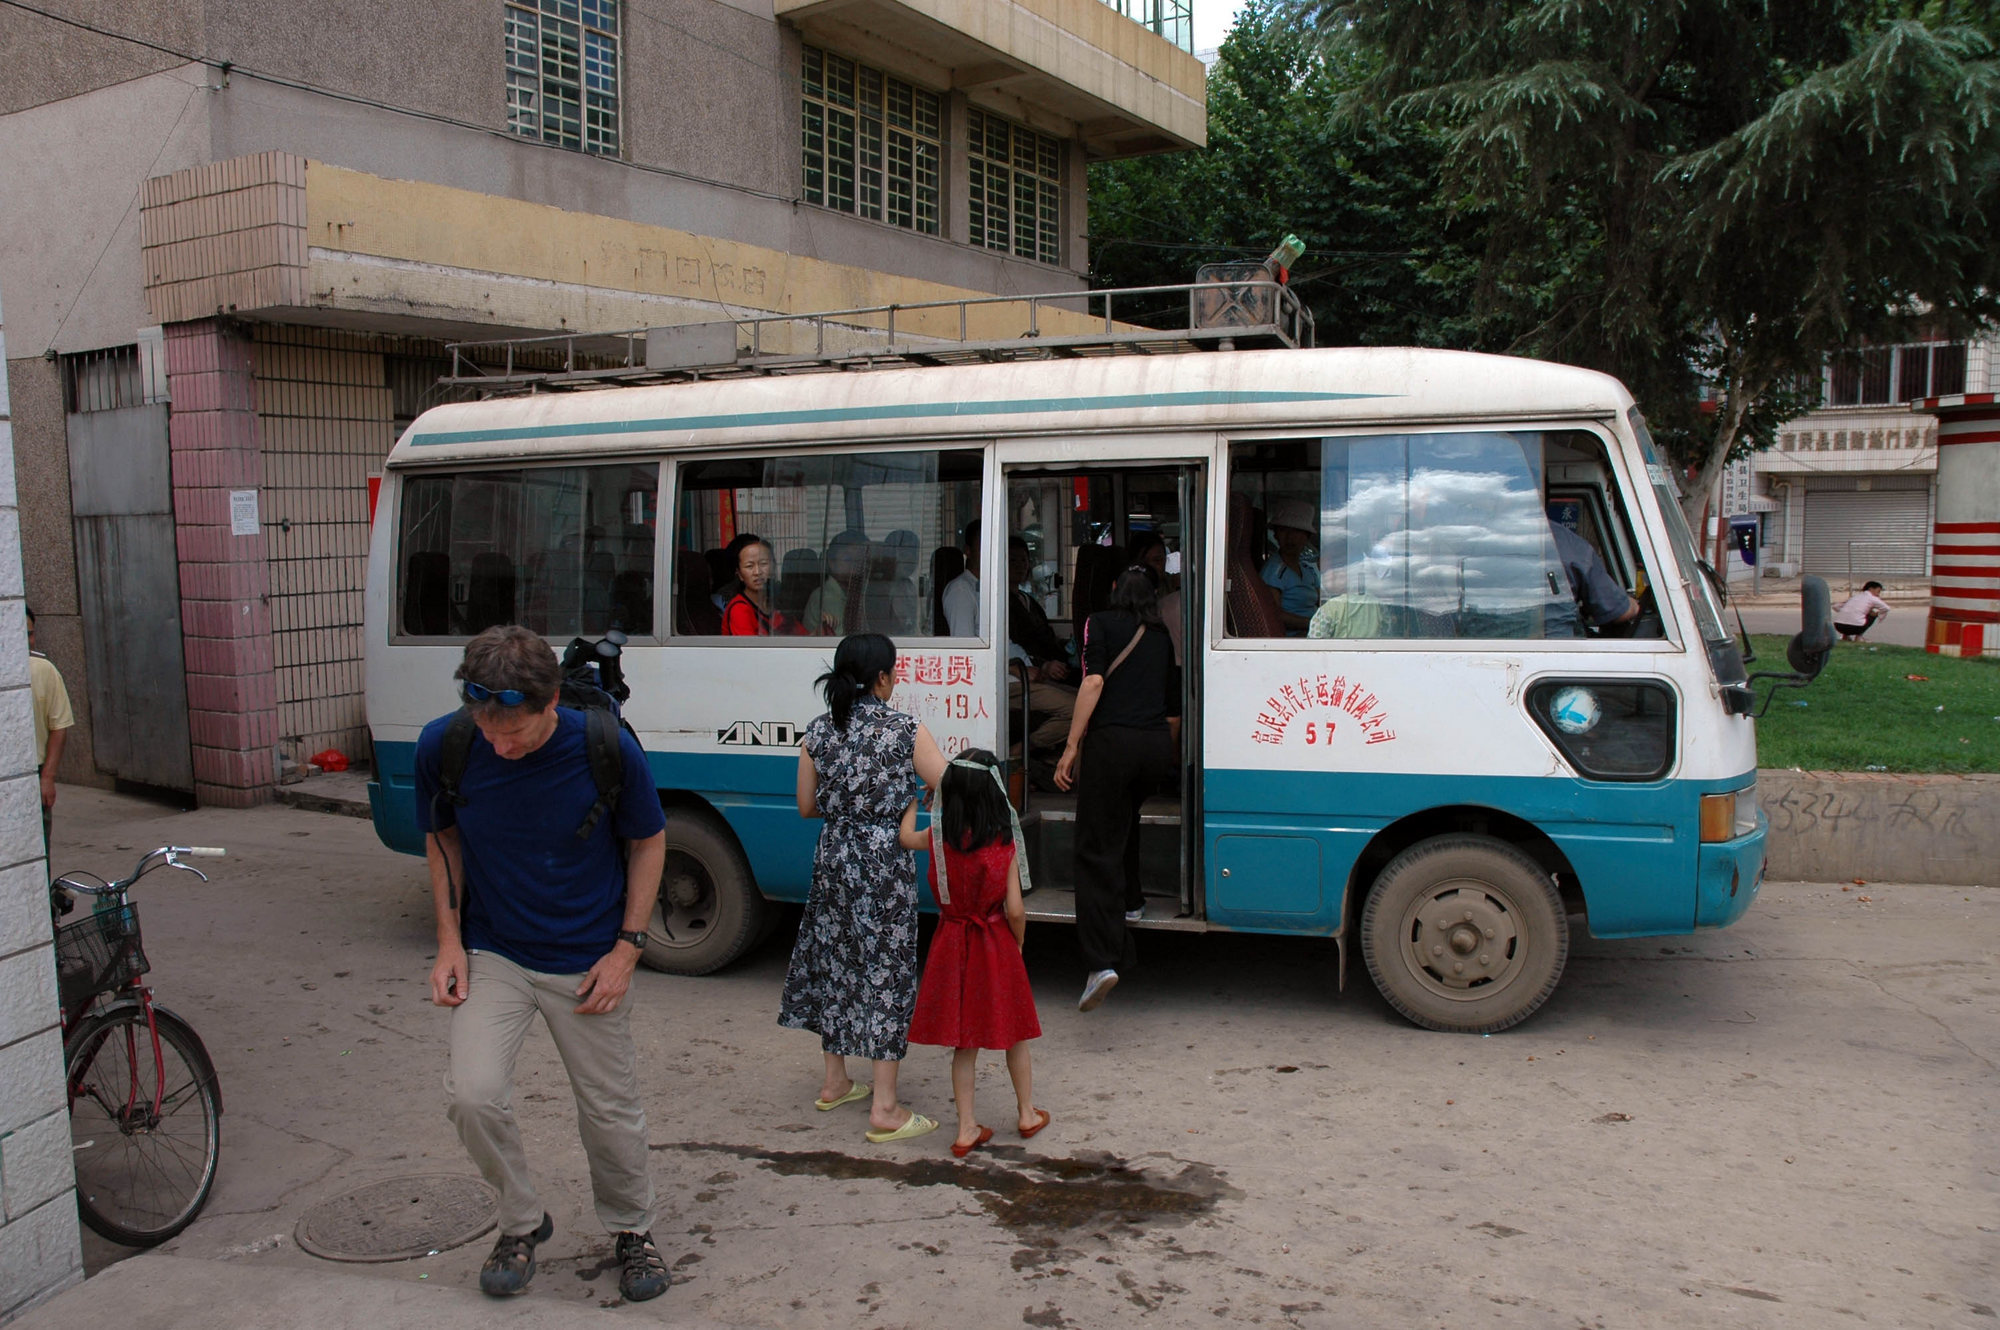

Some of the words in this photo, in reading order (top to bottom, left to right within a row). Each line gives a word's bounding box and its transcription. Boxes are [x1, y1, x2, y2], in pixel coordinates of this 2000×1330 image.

[1250, 674, 1396, 746] 富民县汽车运输有限公司
